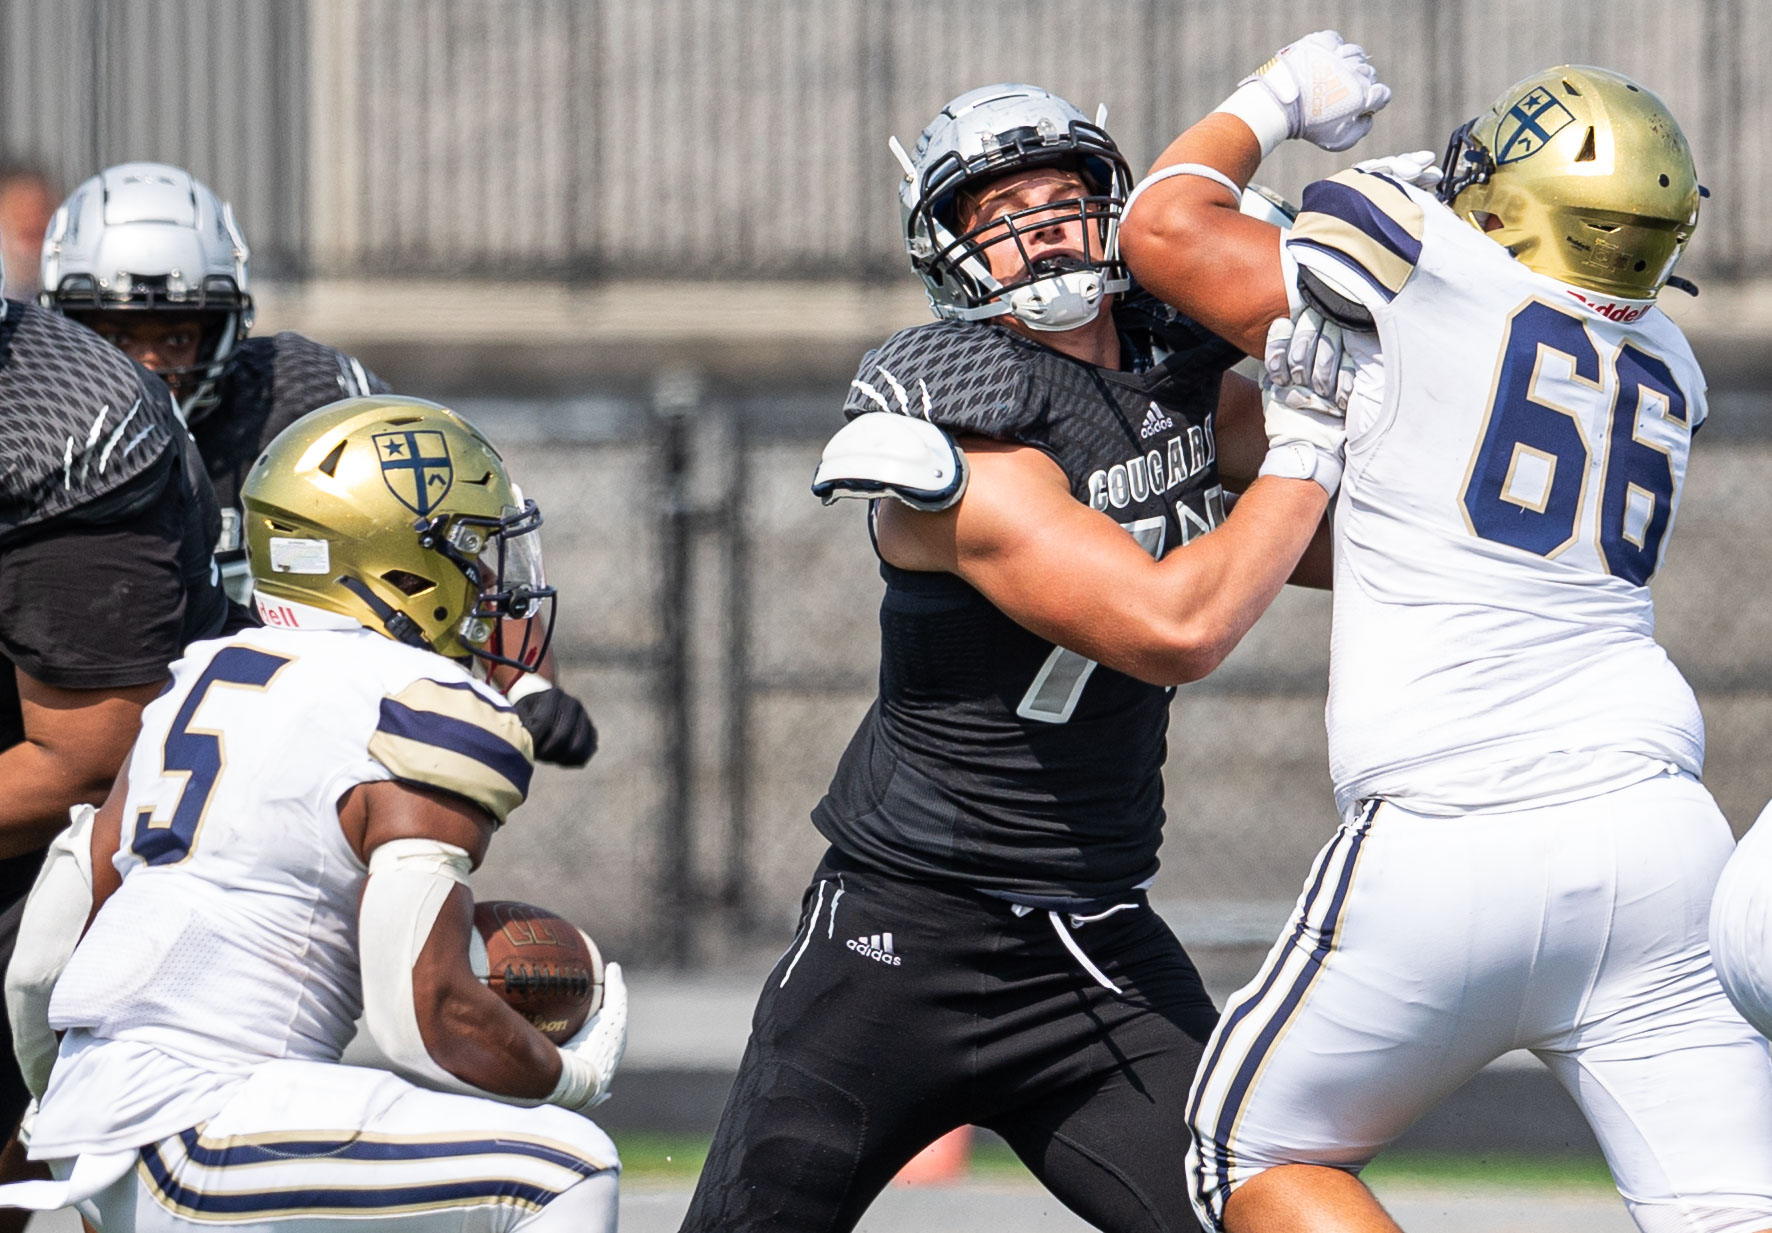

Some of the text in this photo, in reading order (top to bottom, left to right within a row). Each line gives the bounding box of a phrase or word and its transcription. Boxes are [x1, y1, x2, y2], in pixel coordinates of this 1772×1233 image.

[1140, 416, 1174, 439] adidas
[1456, 293, 1690, 588] 66
[129, 642, 300, 867] 5
[846, 939, 901, 966] adidas
